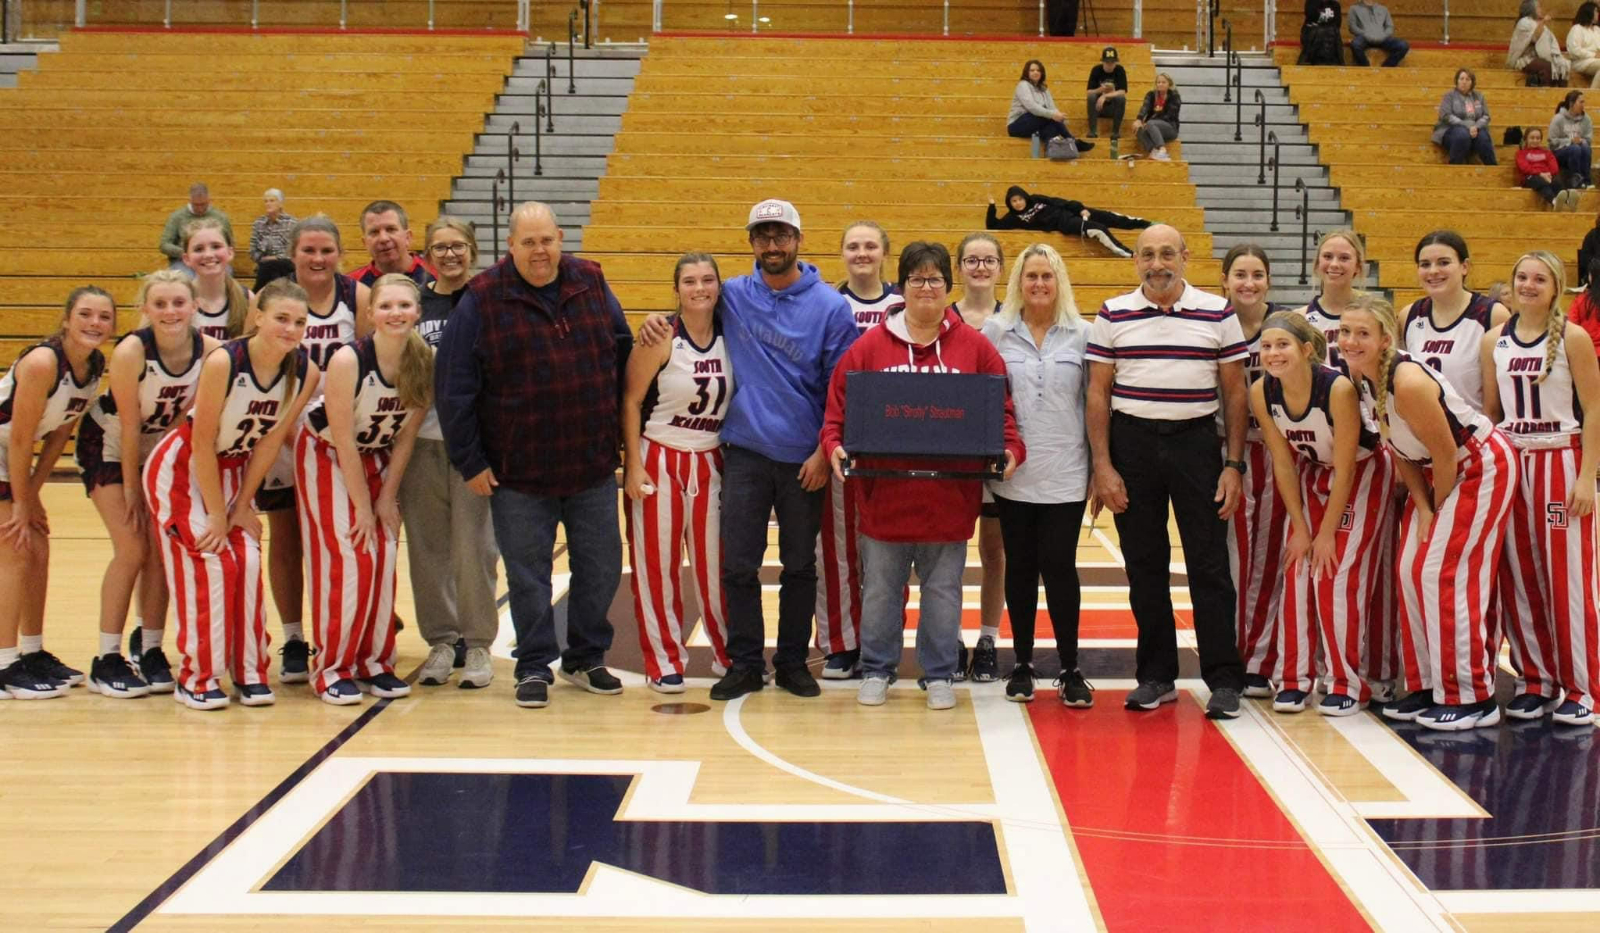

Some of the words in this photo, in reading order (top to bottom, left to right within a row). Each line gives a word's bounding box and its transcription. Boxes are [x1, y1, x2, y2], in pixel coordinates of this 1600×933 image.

[305, 324, 339, 339] SOUTH
[1421, 340, 1455, 354] SOUTH
[693, 358, 723, 374] SOUTH
[1507, 356, 1543, 372] SOUTH
[687, 375, 727, 416] 31
[1510, 374, 1542, 419] 11
[246, 400, 280, 416] SOUTH
[227, 418, 279, 451] 23
[356, 412, 408, 445] 33
